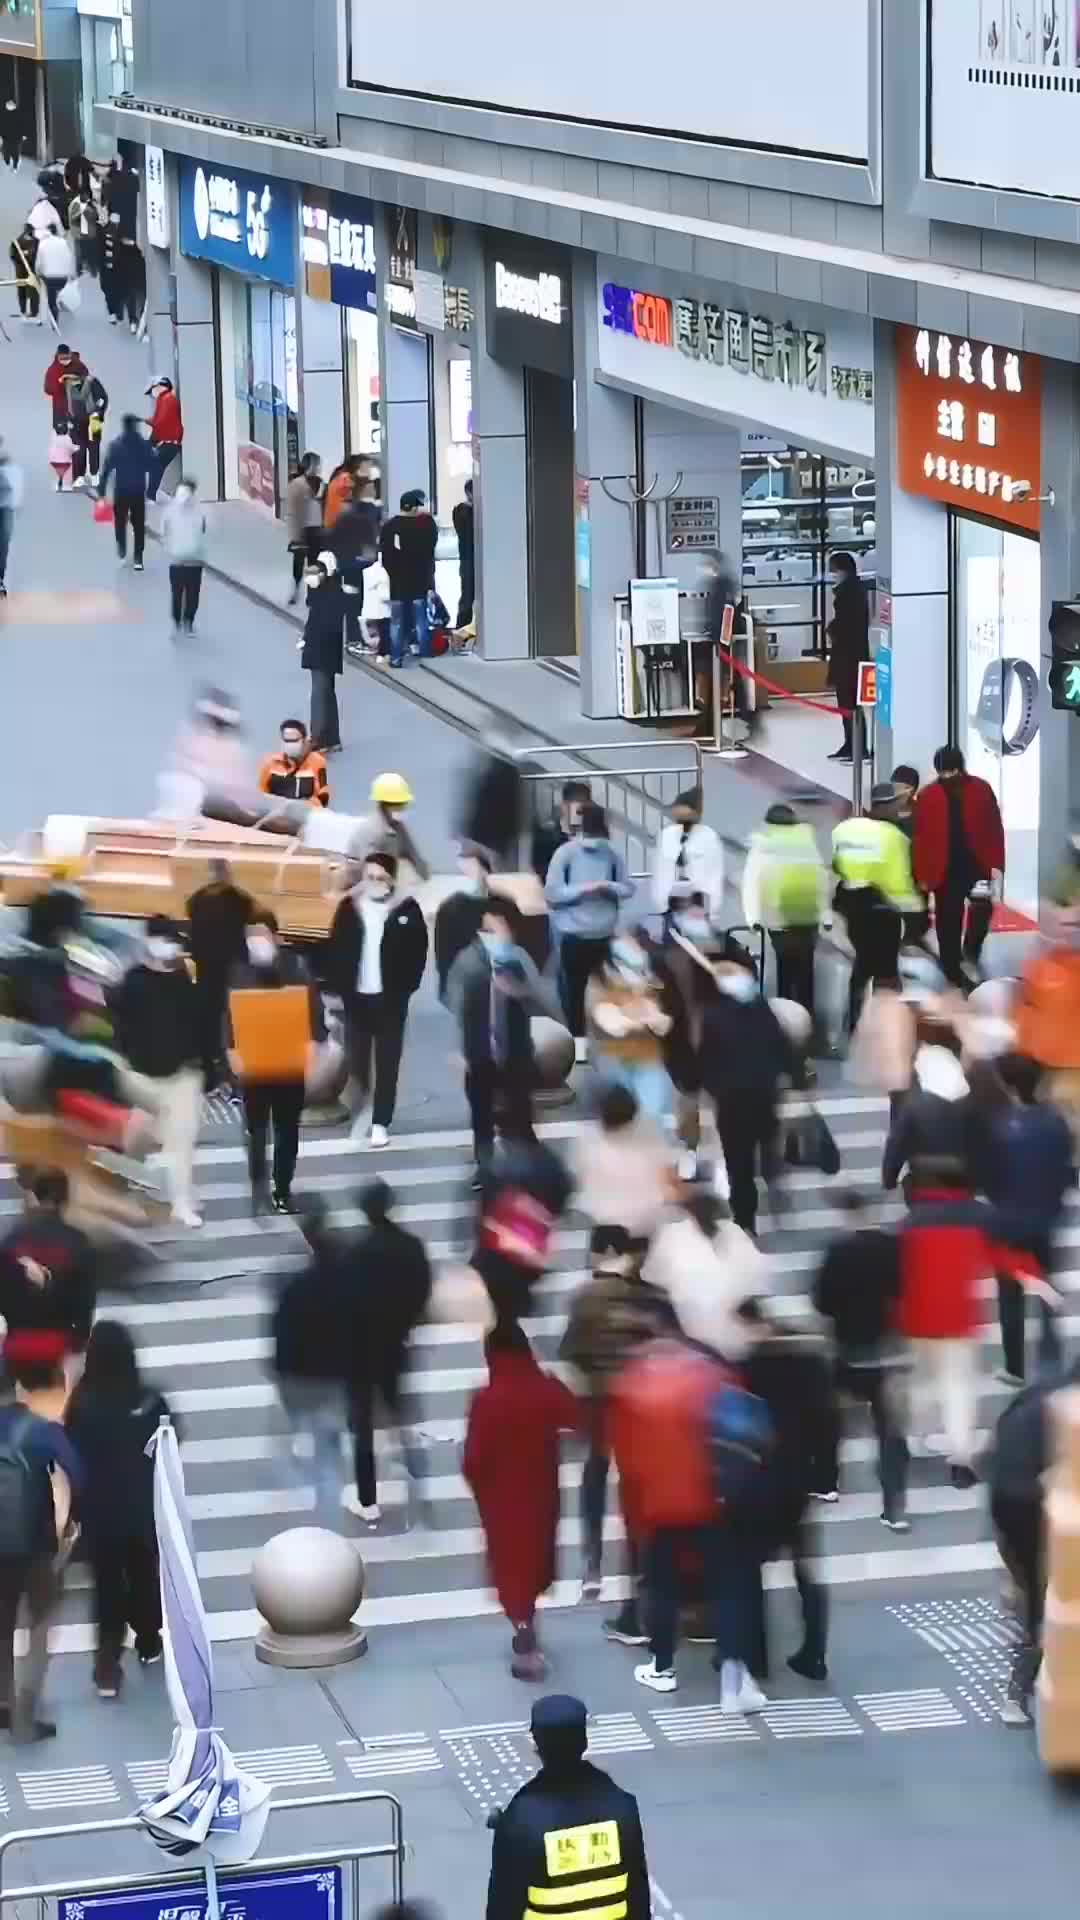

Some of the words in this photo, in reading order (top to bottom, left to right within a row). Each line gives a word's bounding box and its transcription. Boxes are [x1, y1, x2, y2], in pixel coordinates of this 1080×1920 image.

[675, 298, 827, 397] 赛格通信市场
